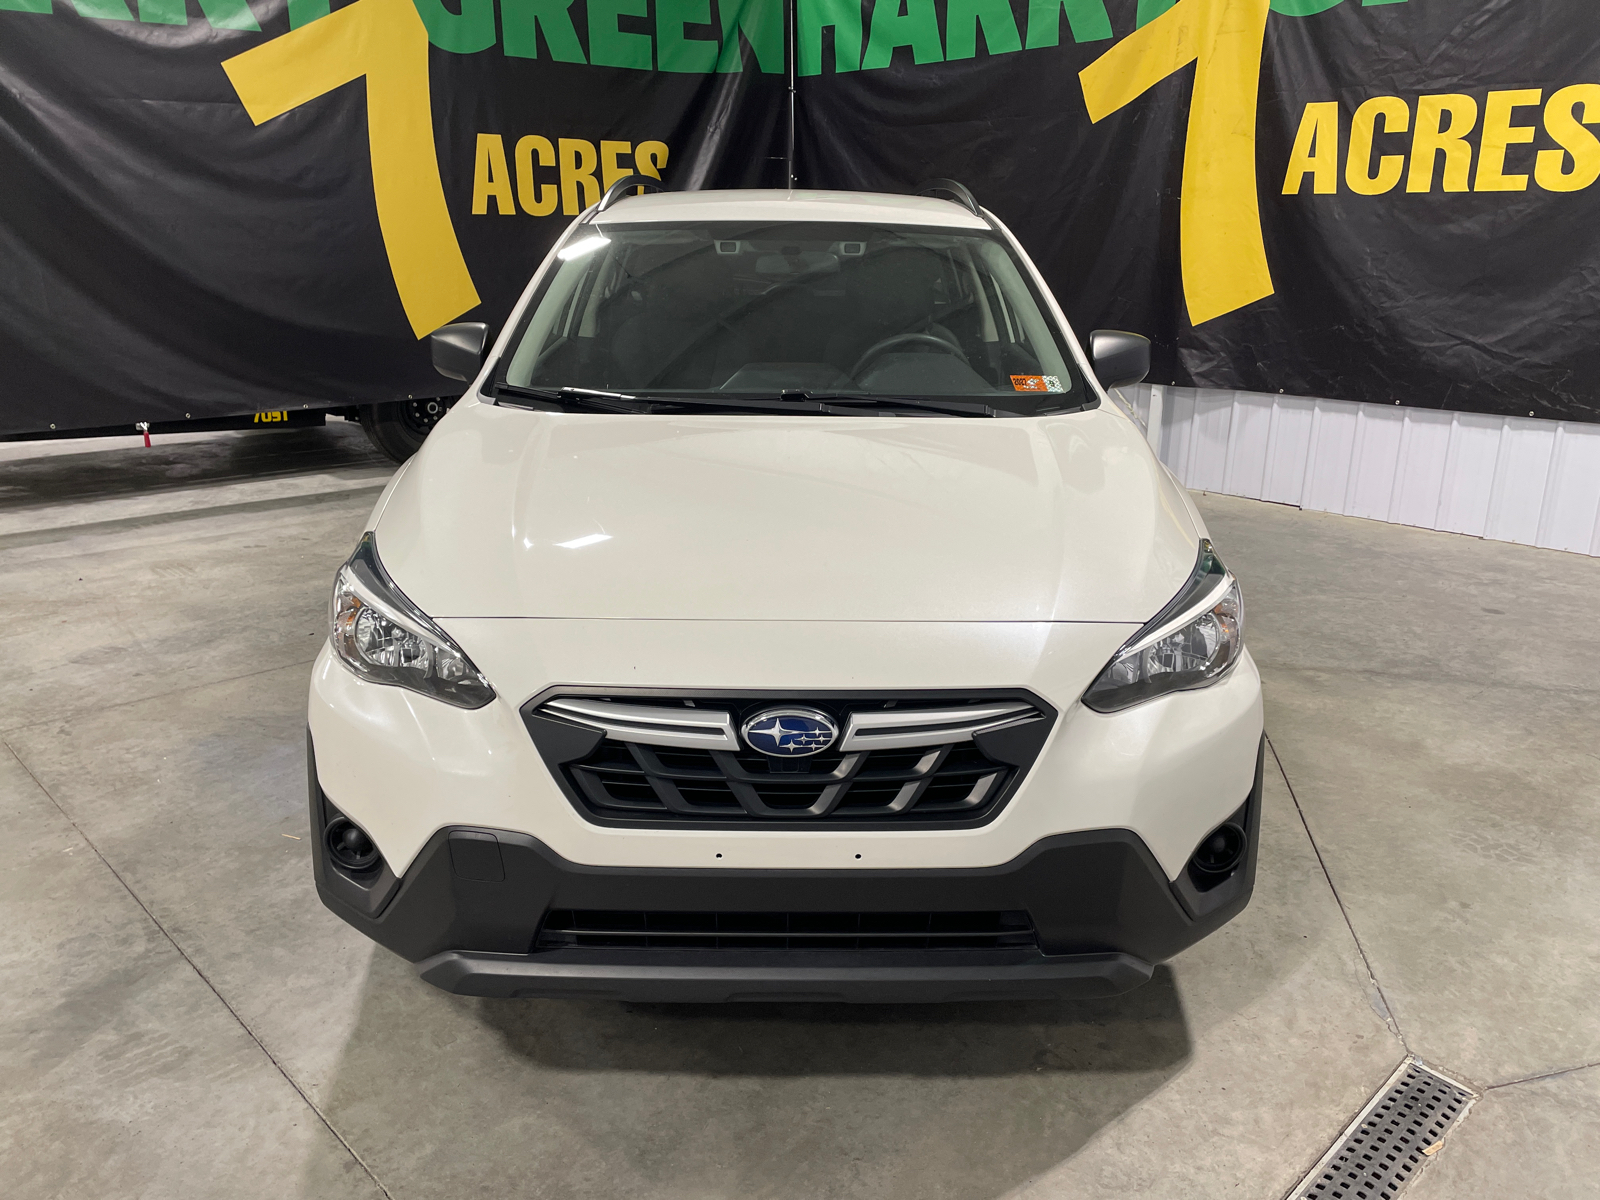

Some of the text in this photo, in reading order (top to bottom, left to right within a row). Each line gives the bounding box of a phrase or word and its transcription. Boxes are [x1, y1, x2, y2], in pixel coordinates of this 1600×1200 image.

[222, 0, 669, 340] 7 ACRES
[1078, 0, 1600, 326] 7 ACRES
